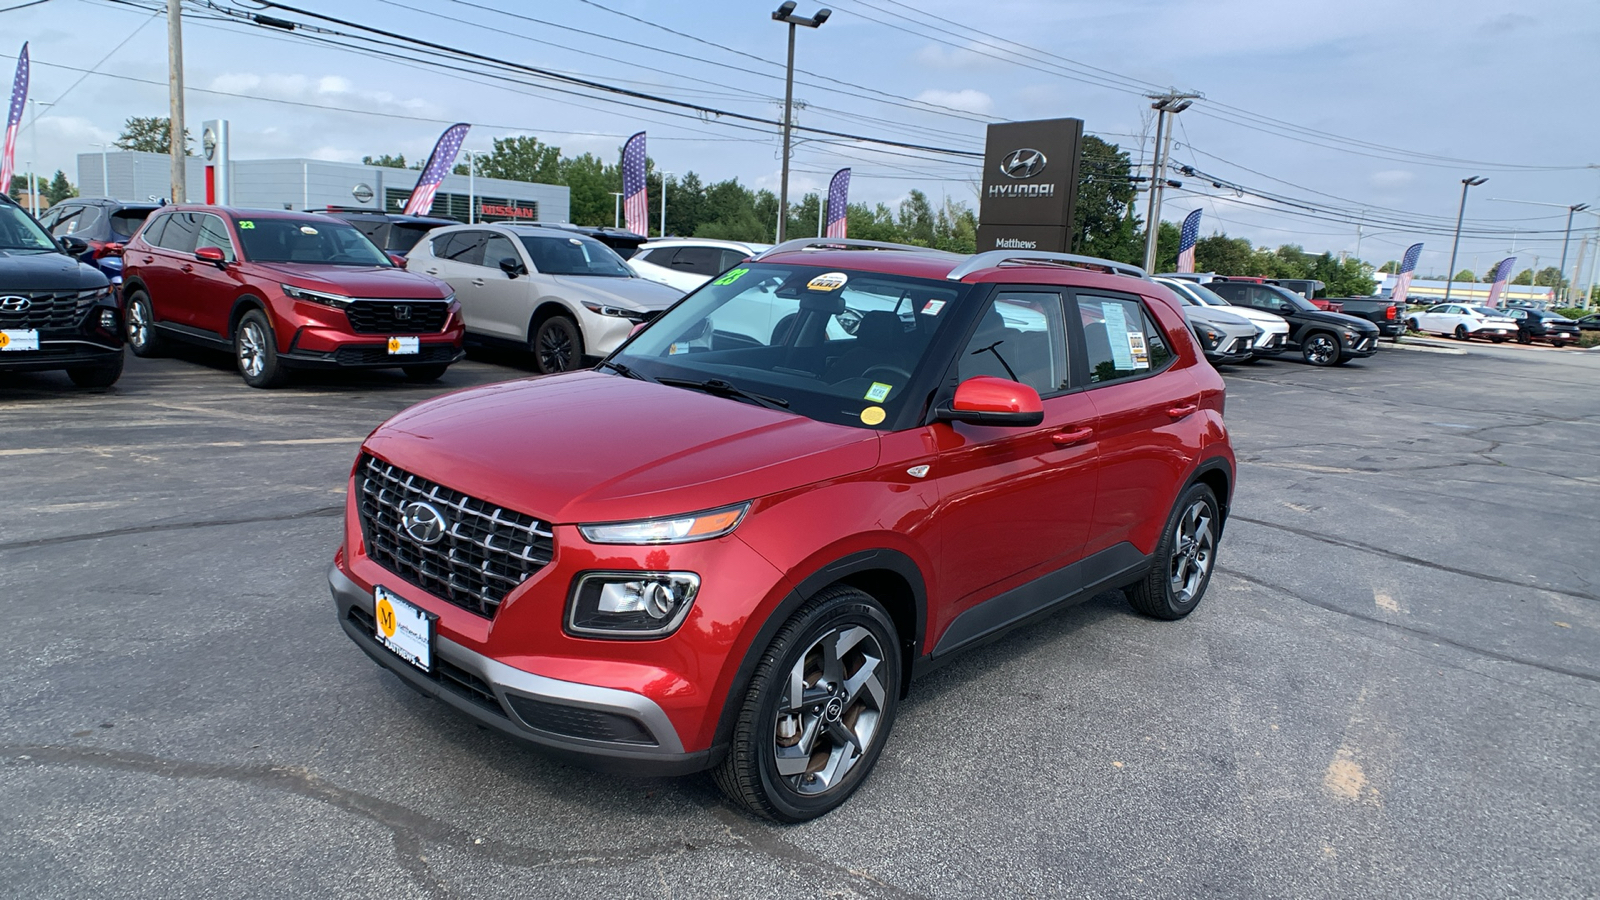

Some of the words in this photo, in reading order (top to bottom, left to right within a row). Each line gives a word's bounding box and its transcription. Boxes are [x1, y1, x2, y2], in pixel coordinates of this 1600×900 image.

[988, 183, 1054, 197] HYUNDAI
[481, 204, 533, 218] NISSAN
[239, 221, 255, 229] 23
[995, 237, 1037, 249] Matthews
[713, 268, 750, 286] 23
[380, 606, 393, 631] M
